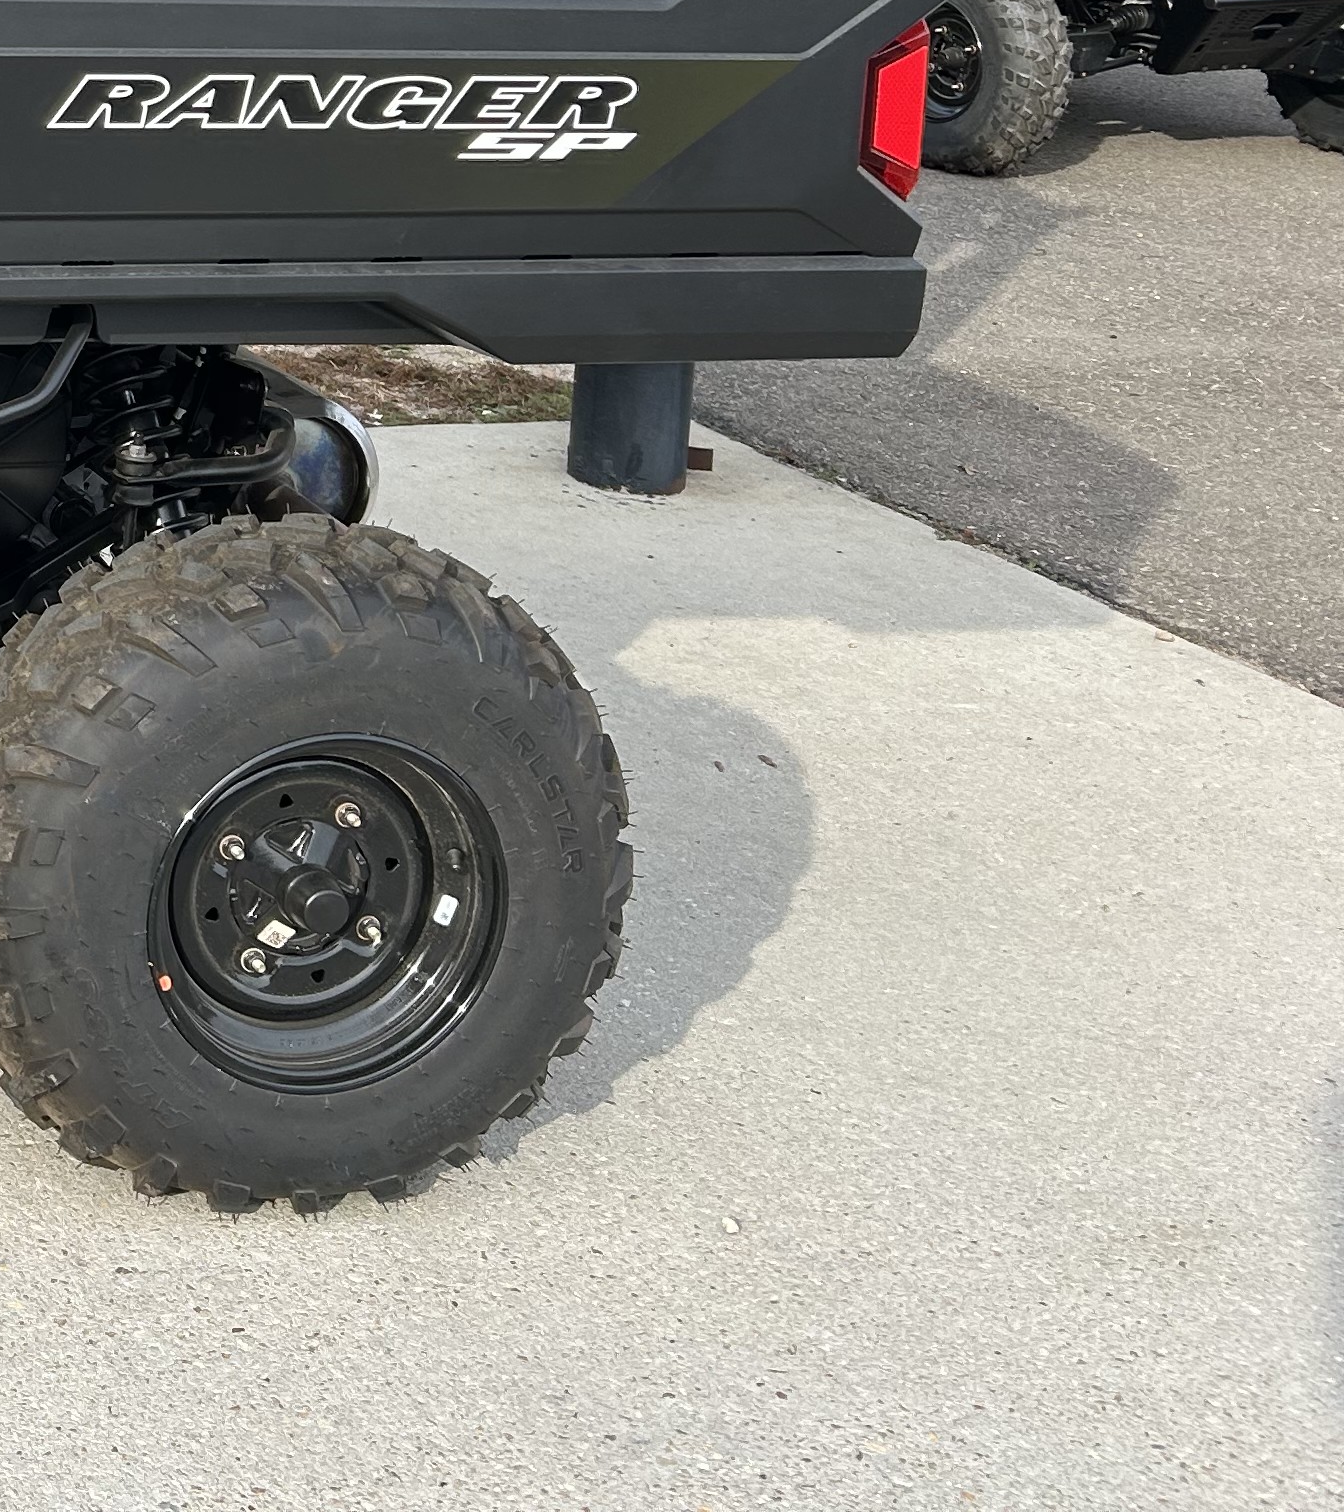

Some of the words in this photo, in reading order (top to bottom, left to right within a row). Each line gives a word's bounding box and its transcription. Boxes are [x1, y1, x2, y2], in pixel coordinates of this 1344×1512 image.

[47, 73, 639, 130] RANGER
[456, 131, 638, 161] SP
[473, 696, 583, 873] CARLSTAR
